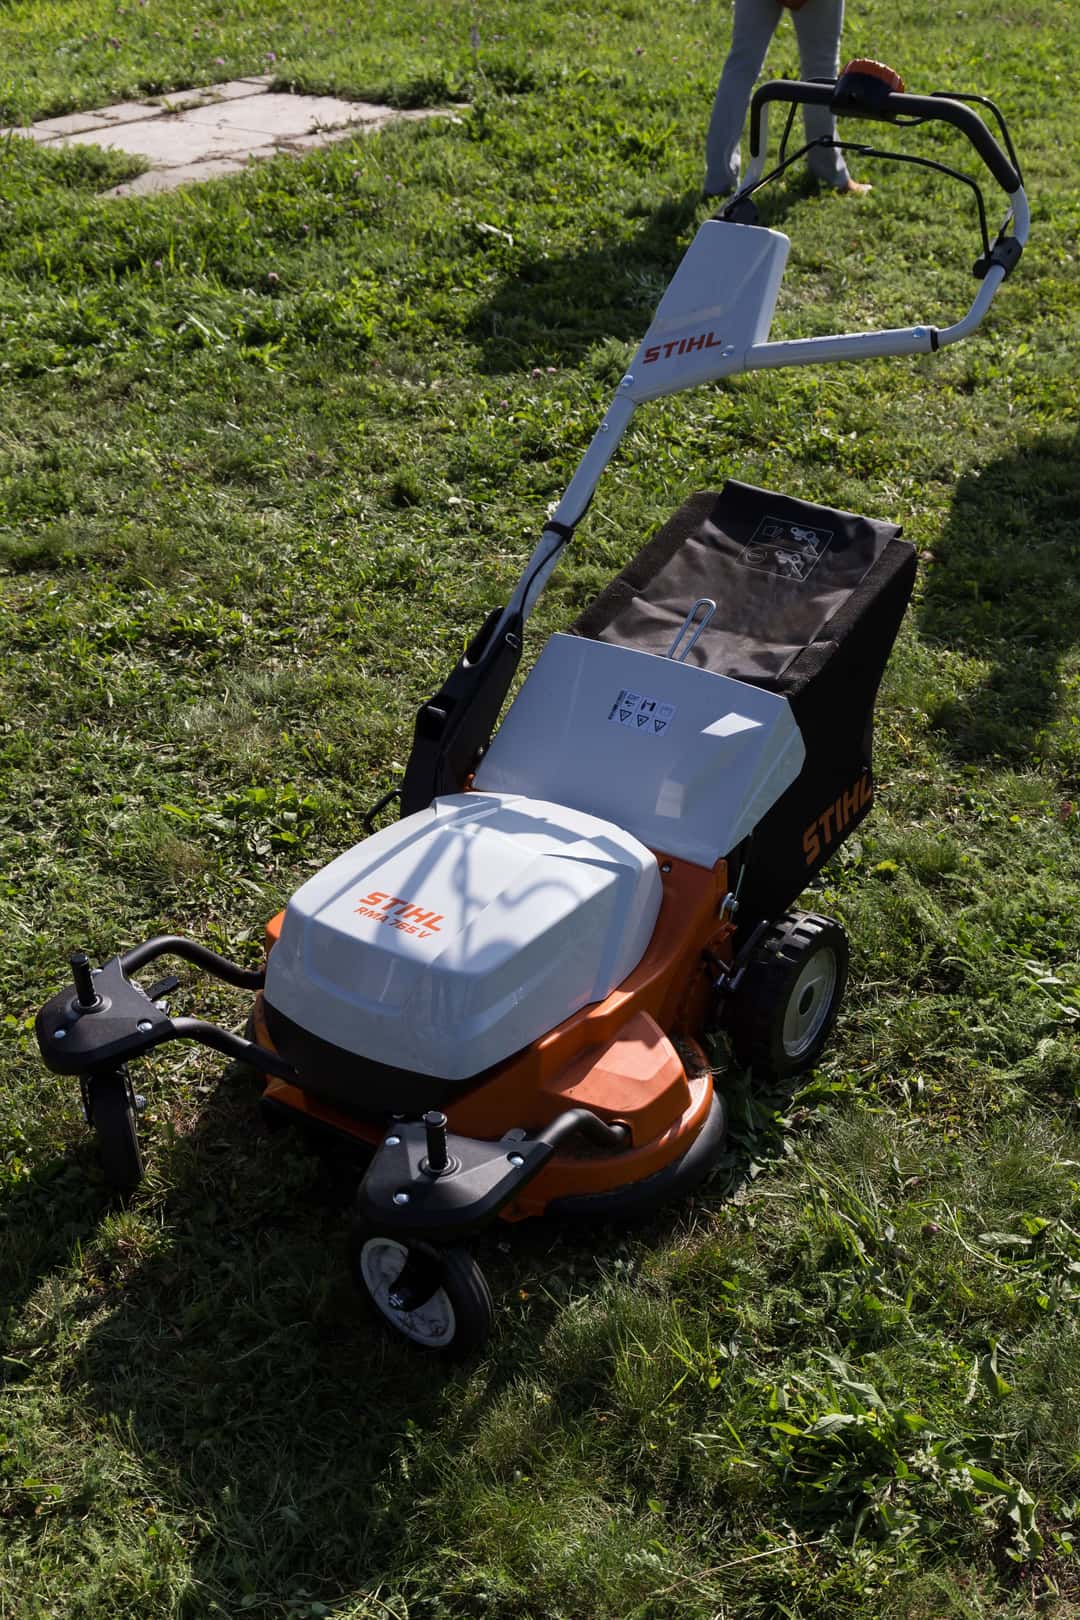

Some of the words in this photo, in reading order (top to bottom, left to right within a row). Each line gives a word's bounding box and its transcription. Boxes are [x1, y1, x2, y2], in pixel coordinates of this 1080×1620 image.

[643, 332, 721, 364] STIHL
[803, 774, 872, 865] STIHL
[353, 906, 389, 923] RMA
[388, 918, 419, 935] 765
[417, 930, 432, 939] V
[359, 891, 444, 932] STIHL
